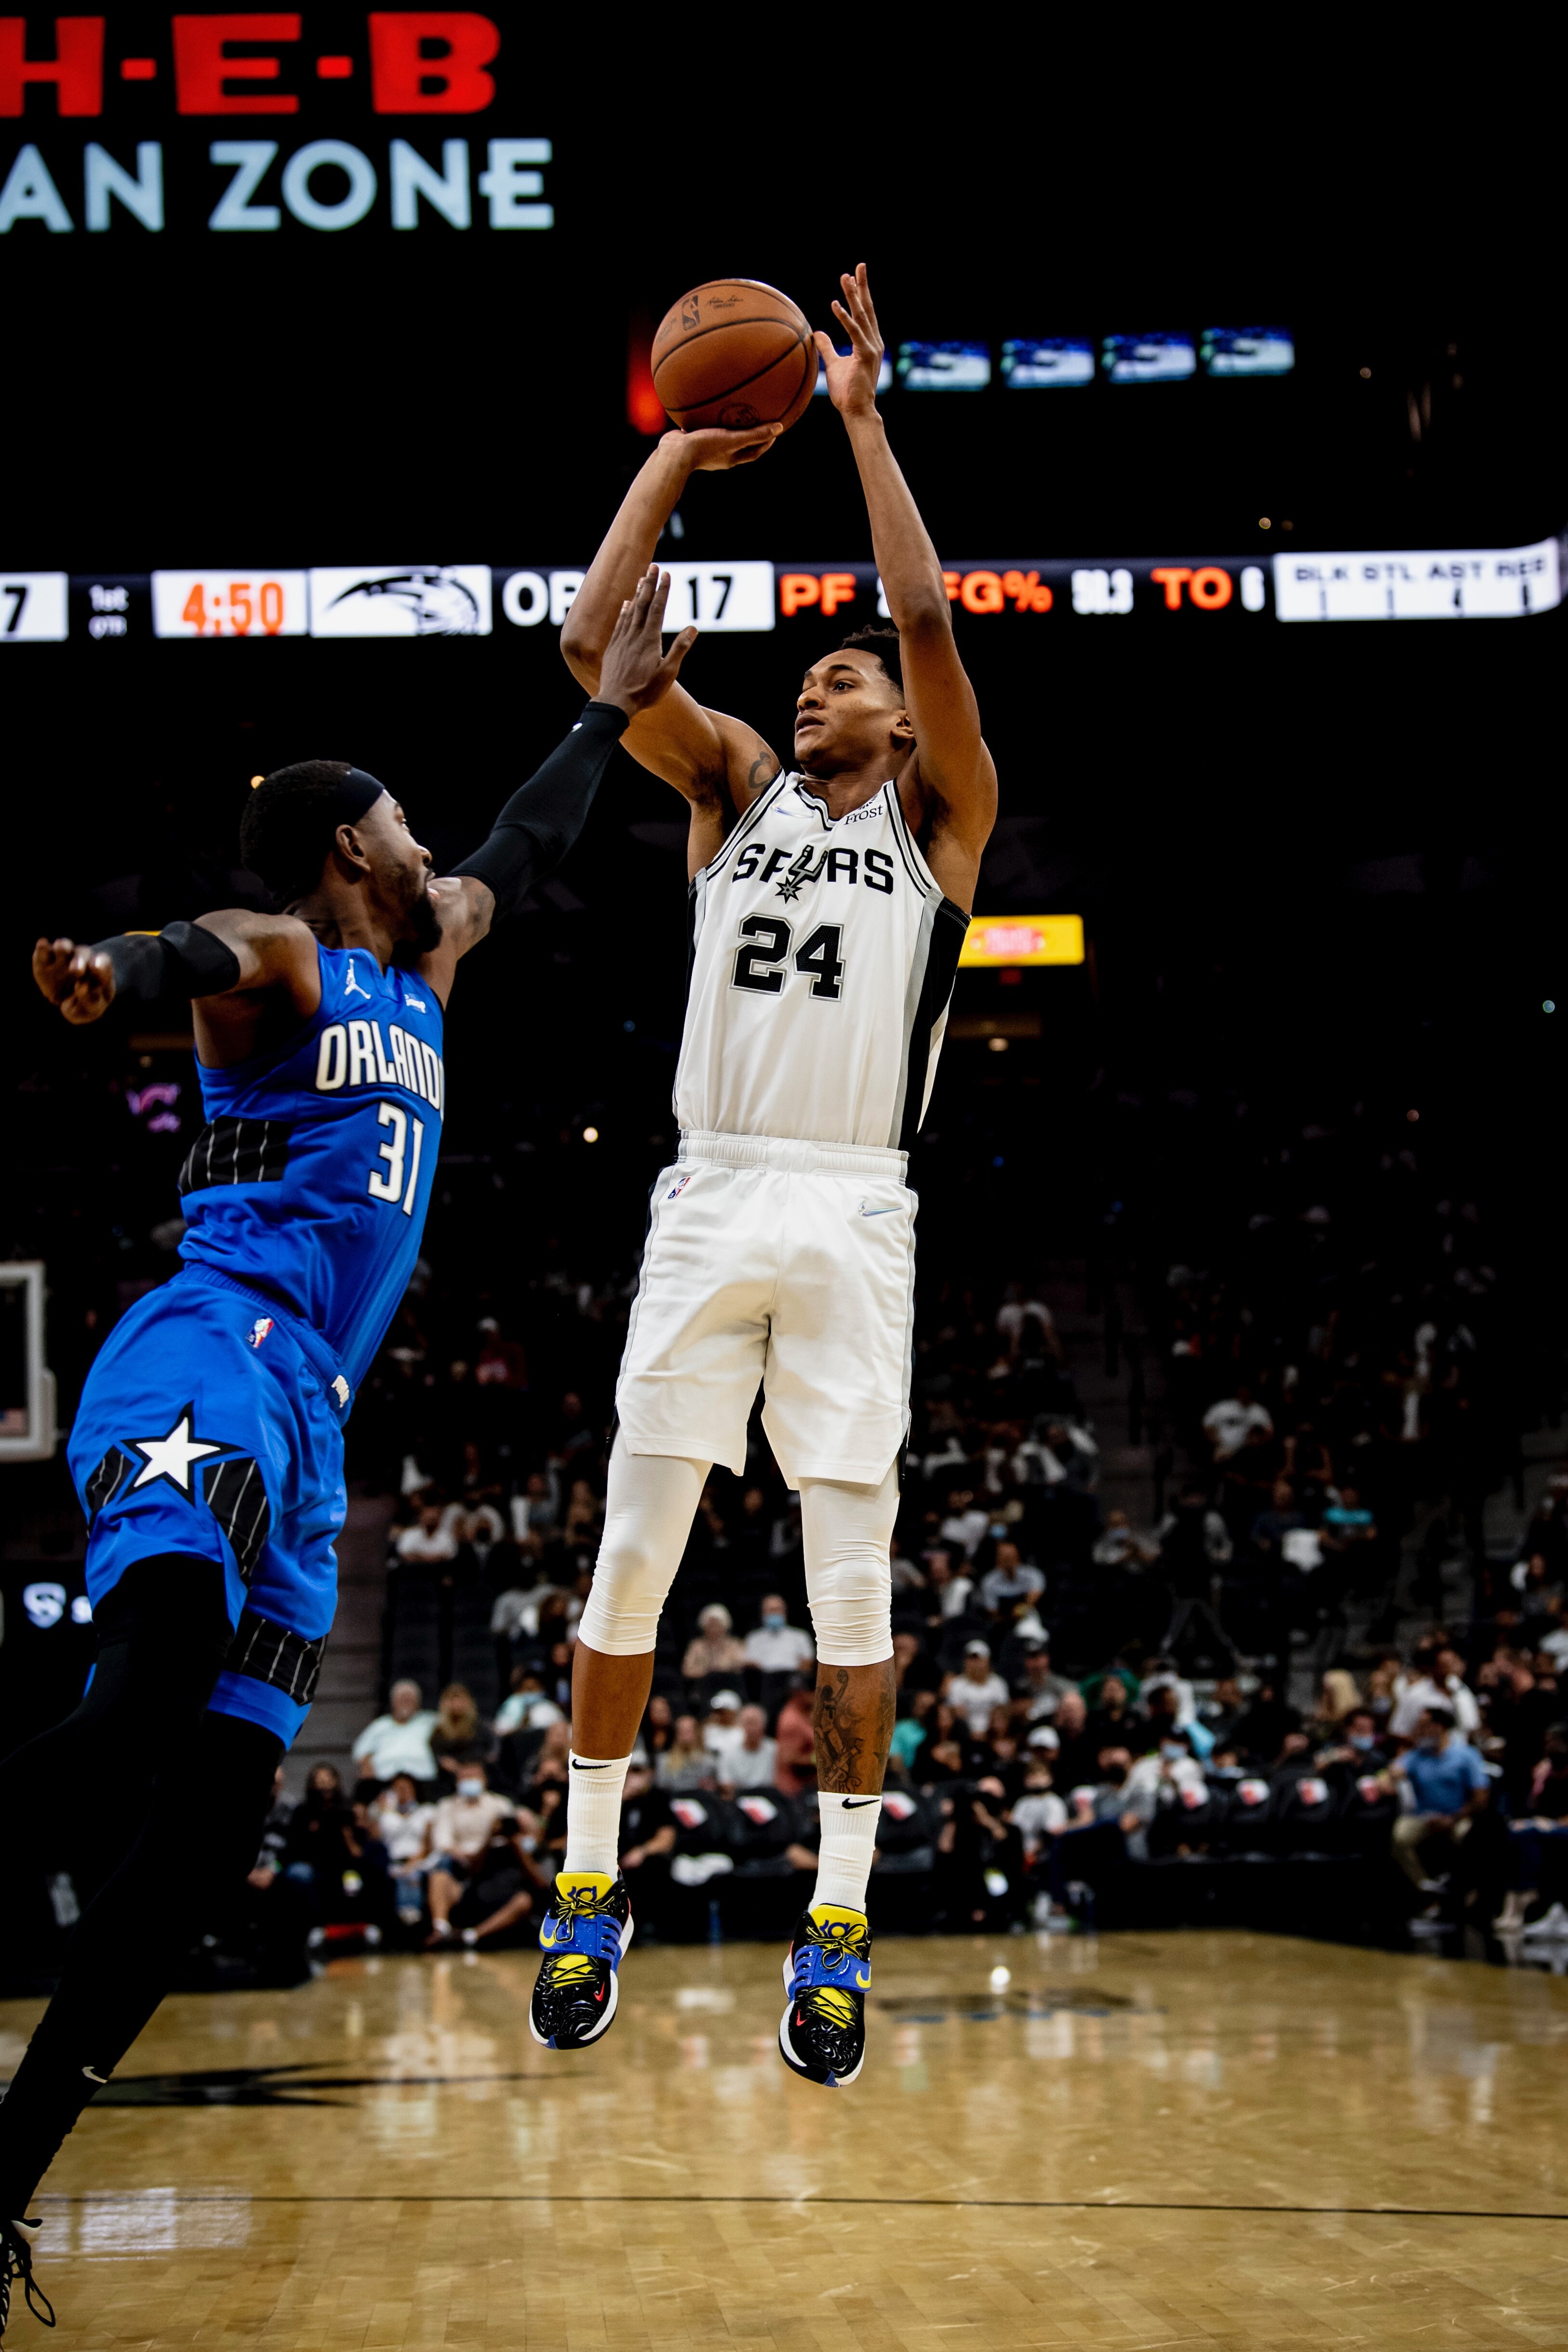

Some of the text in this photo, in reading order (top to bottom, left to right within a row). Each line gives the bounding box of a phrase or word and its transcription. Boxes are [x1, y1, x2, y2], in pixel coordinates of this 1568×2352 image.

[0, 11, 501, 117] H-E-B
[209, 138, 554, 231] ZONE
[182, 581, 284, 636] 4:50
[688, 575, 732, 620] 17
[779, 573, 856, 617] PF
[1151, 567, 1234, 611] TO
[843, 804, 884, 825] Frost
[730, 912, 846, 1003] 24
[367, 1100, 425, 1216] 31
